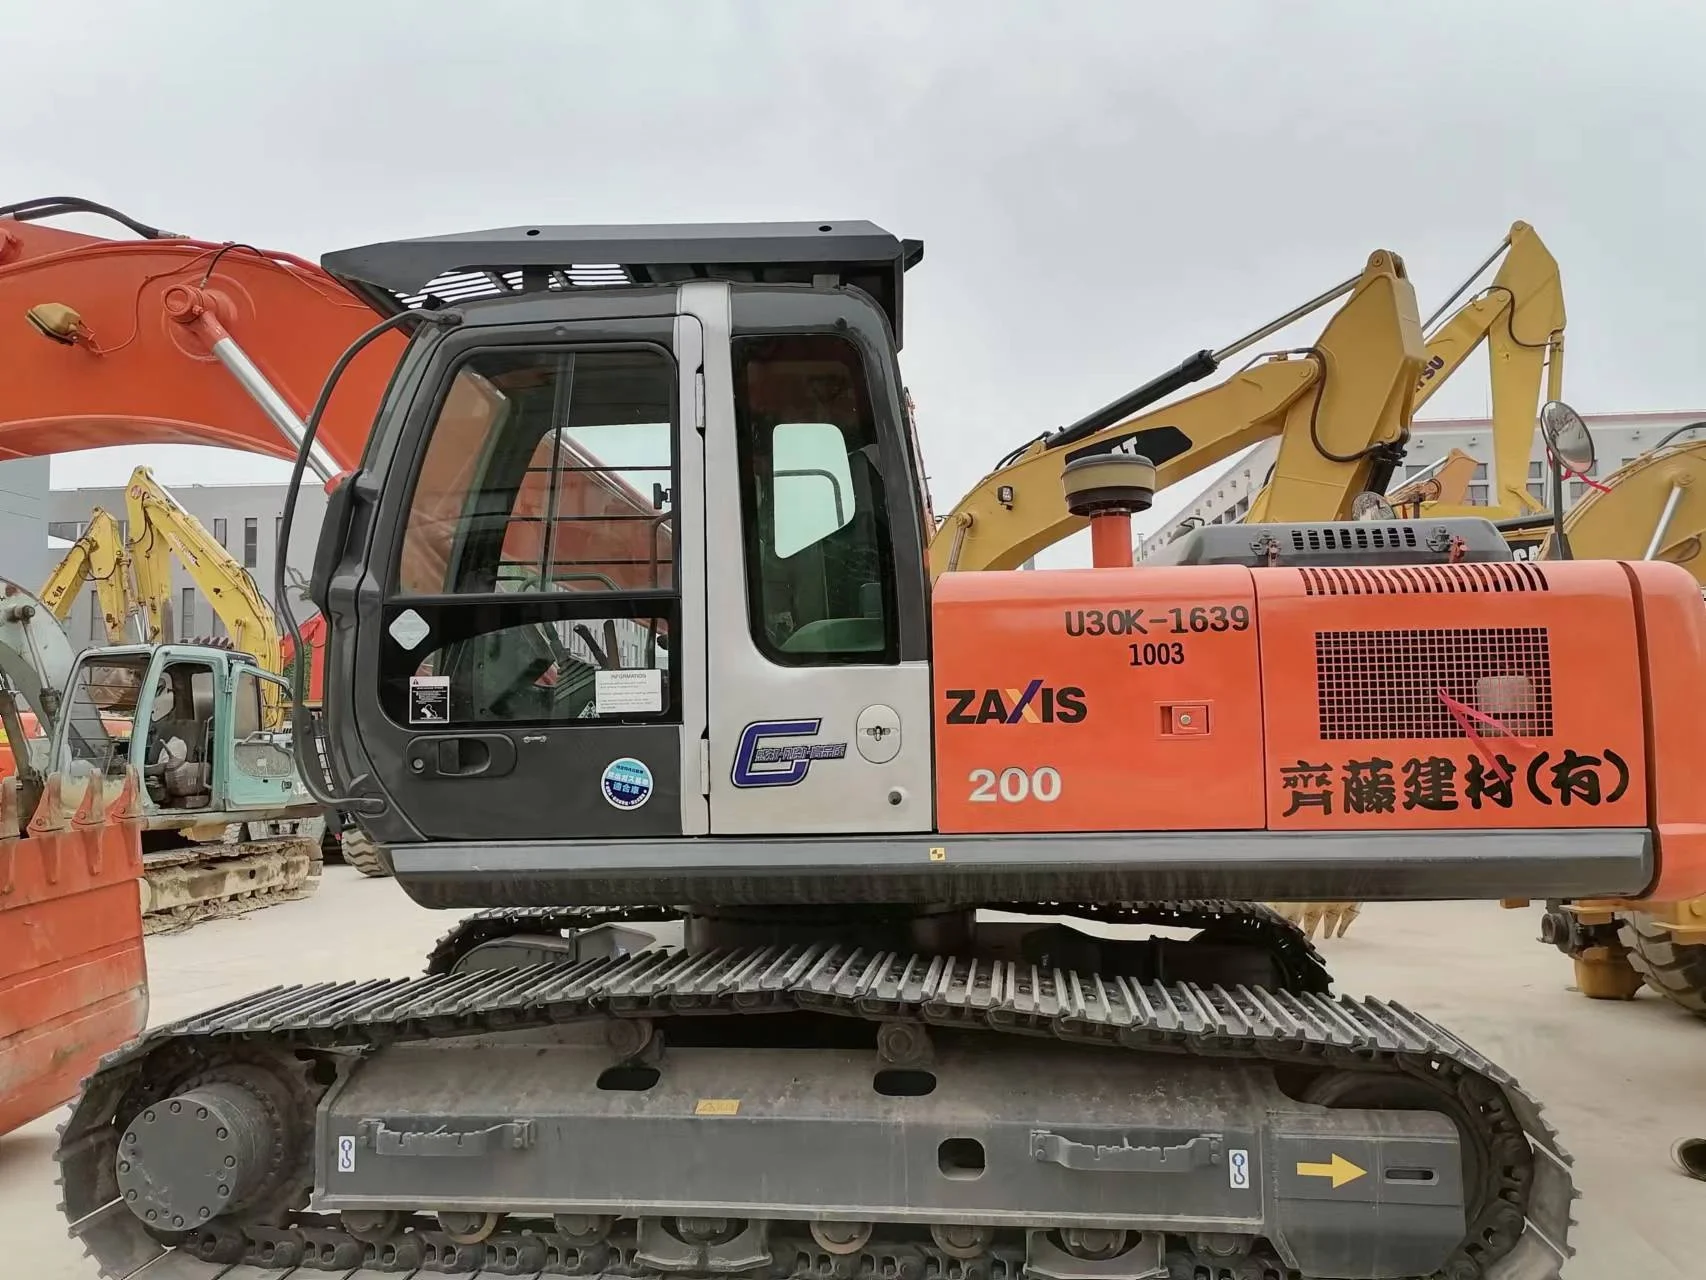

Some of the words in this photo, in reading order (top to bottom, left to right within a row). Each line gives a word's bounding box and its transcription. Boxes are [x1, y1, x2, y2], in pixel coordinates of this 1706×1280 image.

[1111, 436, 1138, 455] AT
[1065, 605, 1249, 637] U30K-1639
[1128, 642, 1185, 666] 1003
[946, 680, 1088, 724] ZAXIS
[968, 767, 1062, 803] 200
